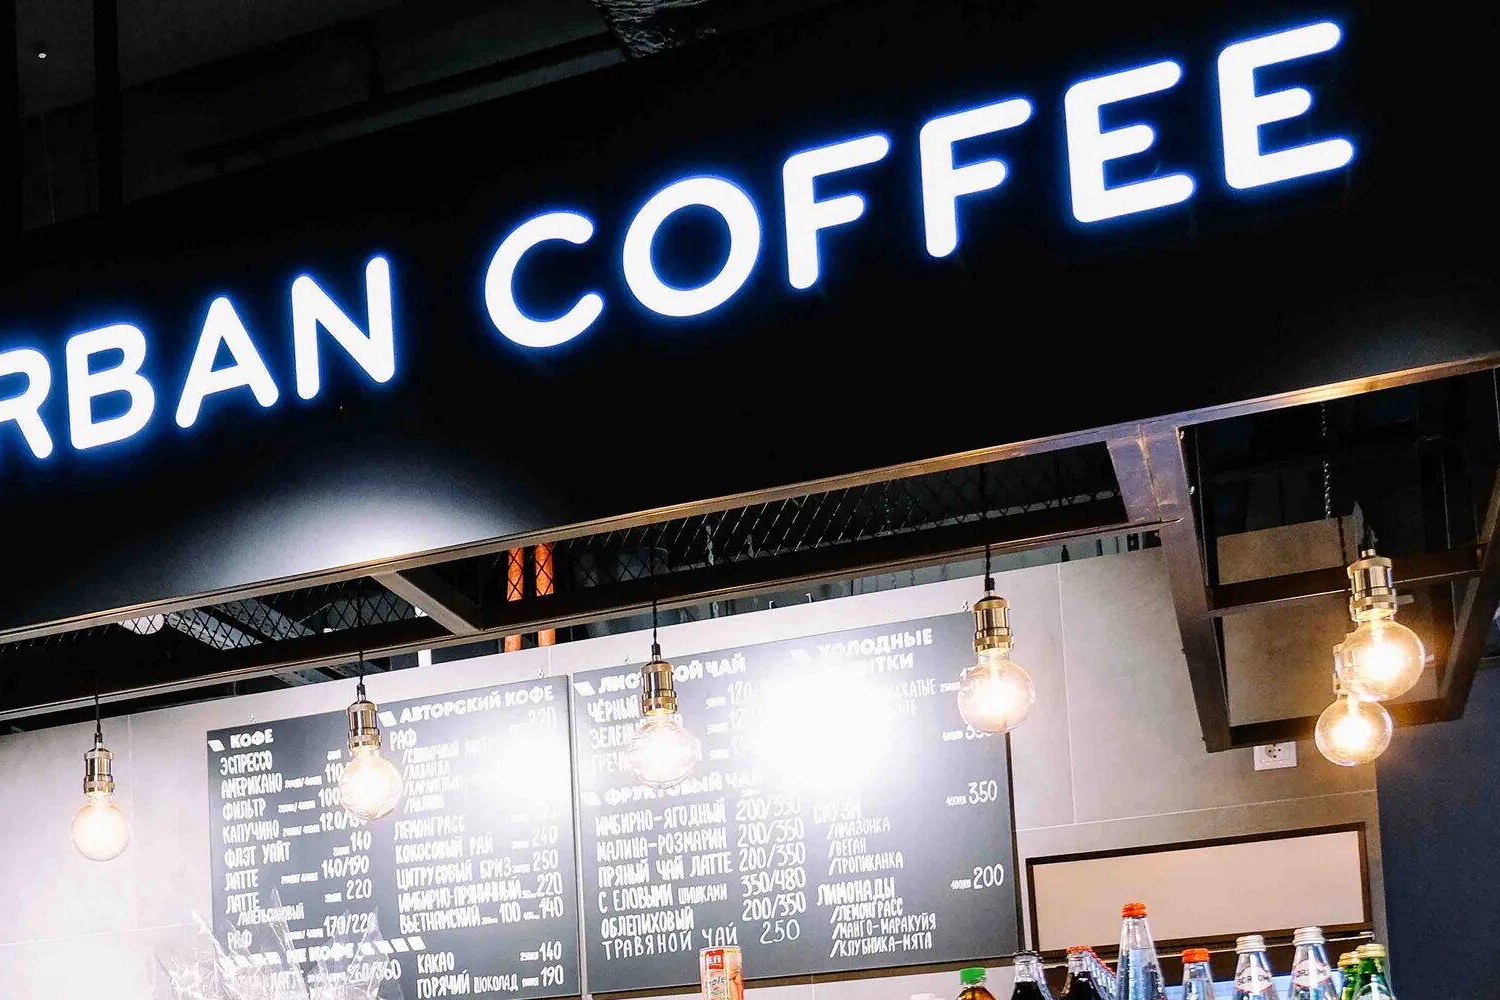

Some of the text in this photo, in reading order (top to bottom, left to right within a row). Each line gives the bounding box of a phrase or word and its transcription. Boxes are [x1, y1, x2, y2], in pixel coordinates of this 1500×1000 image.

[484, 20, 1356, 348] COFFEE
[706, 652, 746, 678] ЧАЙ
[400, 685, 554, 724] АВТОРСКИЙ КОФЕ
[229, 728, 274, 750] КОФЕ
[389, 728, 417, 751] РАФ
[220, 750, 273, 776] ЭСПРЕССО
[221, 772, 282, 799] АМЕРИКАНО
[968, 779, 998, 804] 350
[223, 798, 266, 821] ФИЛЬТР
[596, 797, 726, 837] ИМБИРНО-ЯГОДНЫЙ
[222, 820, 279, 844] КАПУЧИНО
[224, 846, 256, 869] ФЛЭТ
[262, 841, 291, 865] УАЙТ
[350, 831, 372, 852] 140
[470, 832, 493, 857] РАЙ
[597, 816, 805, 862] МАЛИНА-РОЗМАРИН 200/350
[225, 869, 259, 891] ЛАТТЕ
[321, 855, 370, 880] 140/190
[396, 860, 473, 890] ЦИТРУСОВЫЙ
[479, 857, 512, 880] БРИЗ
[532, 849, 559, 872] 250
[598, 842, 806, 889] ПРЯНЫЙ ЧАЙ ЛАТТЕ 200/350
[225, 892, 260, 915] ЛАТТЕ
[346, 879, 372, 900] 220
[537, 871, 563, 897] 220
[598, 890, 608, 914] С
[613, 883, 673, 912] ЕЛОВЫМИ
[740, 866, 806, 897] 350/480
[817, 863, 1004, 906] ЛИМОНАДЫ 200
[400, 895, 564, 935] ВЬЕТНАМСКИЙ 100 140
[601, 891, 806, 939] ОБЛЕПИХОВЫЙ 200/350
[417, 940, 562, 974] КАКАО 140
[602, 919, 800, 960] ТРАВЯНОЙ ЧАЙ 250
[417, 969, 471, 999] ГОРЯЧИЙ
[473, 973, 519, 994] ШОКОЛАД
[540, 964, 564, 986] 190
